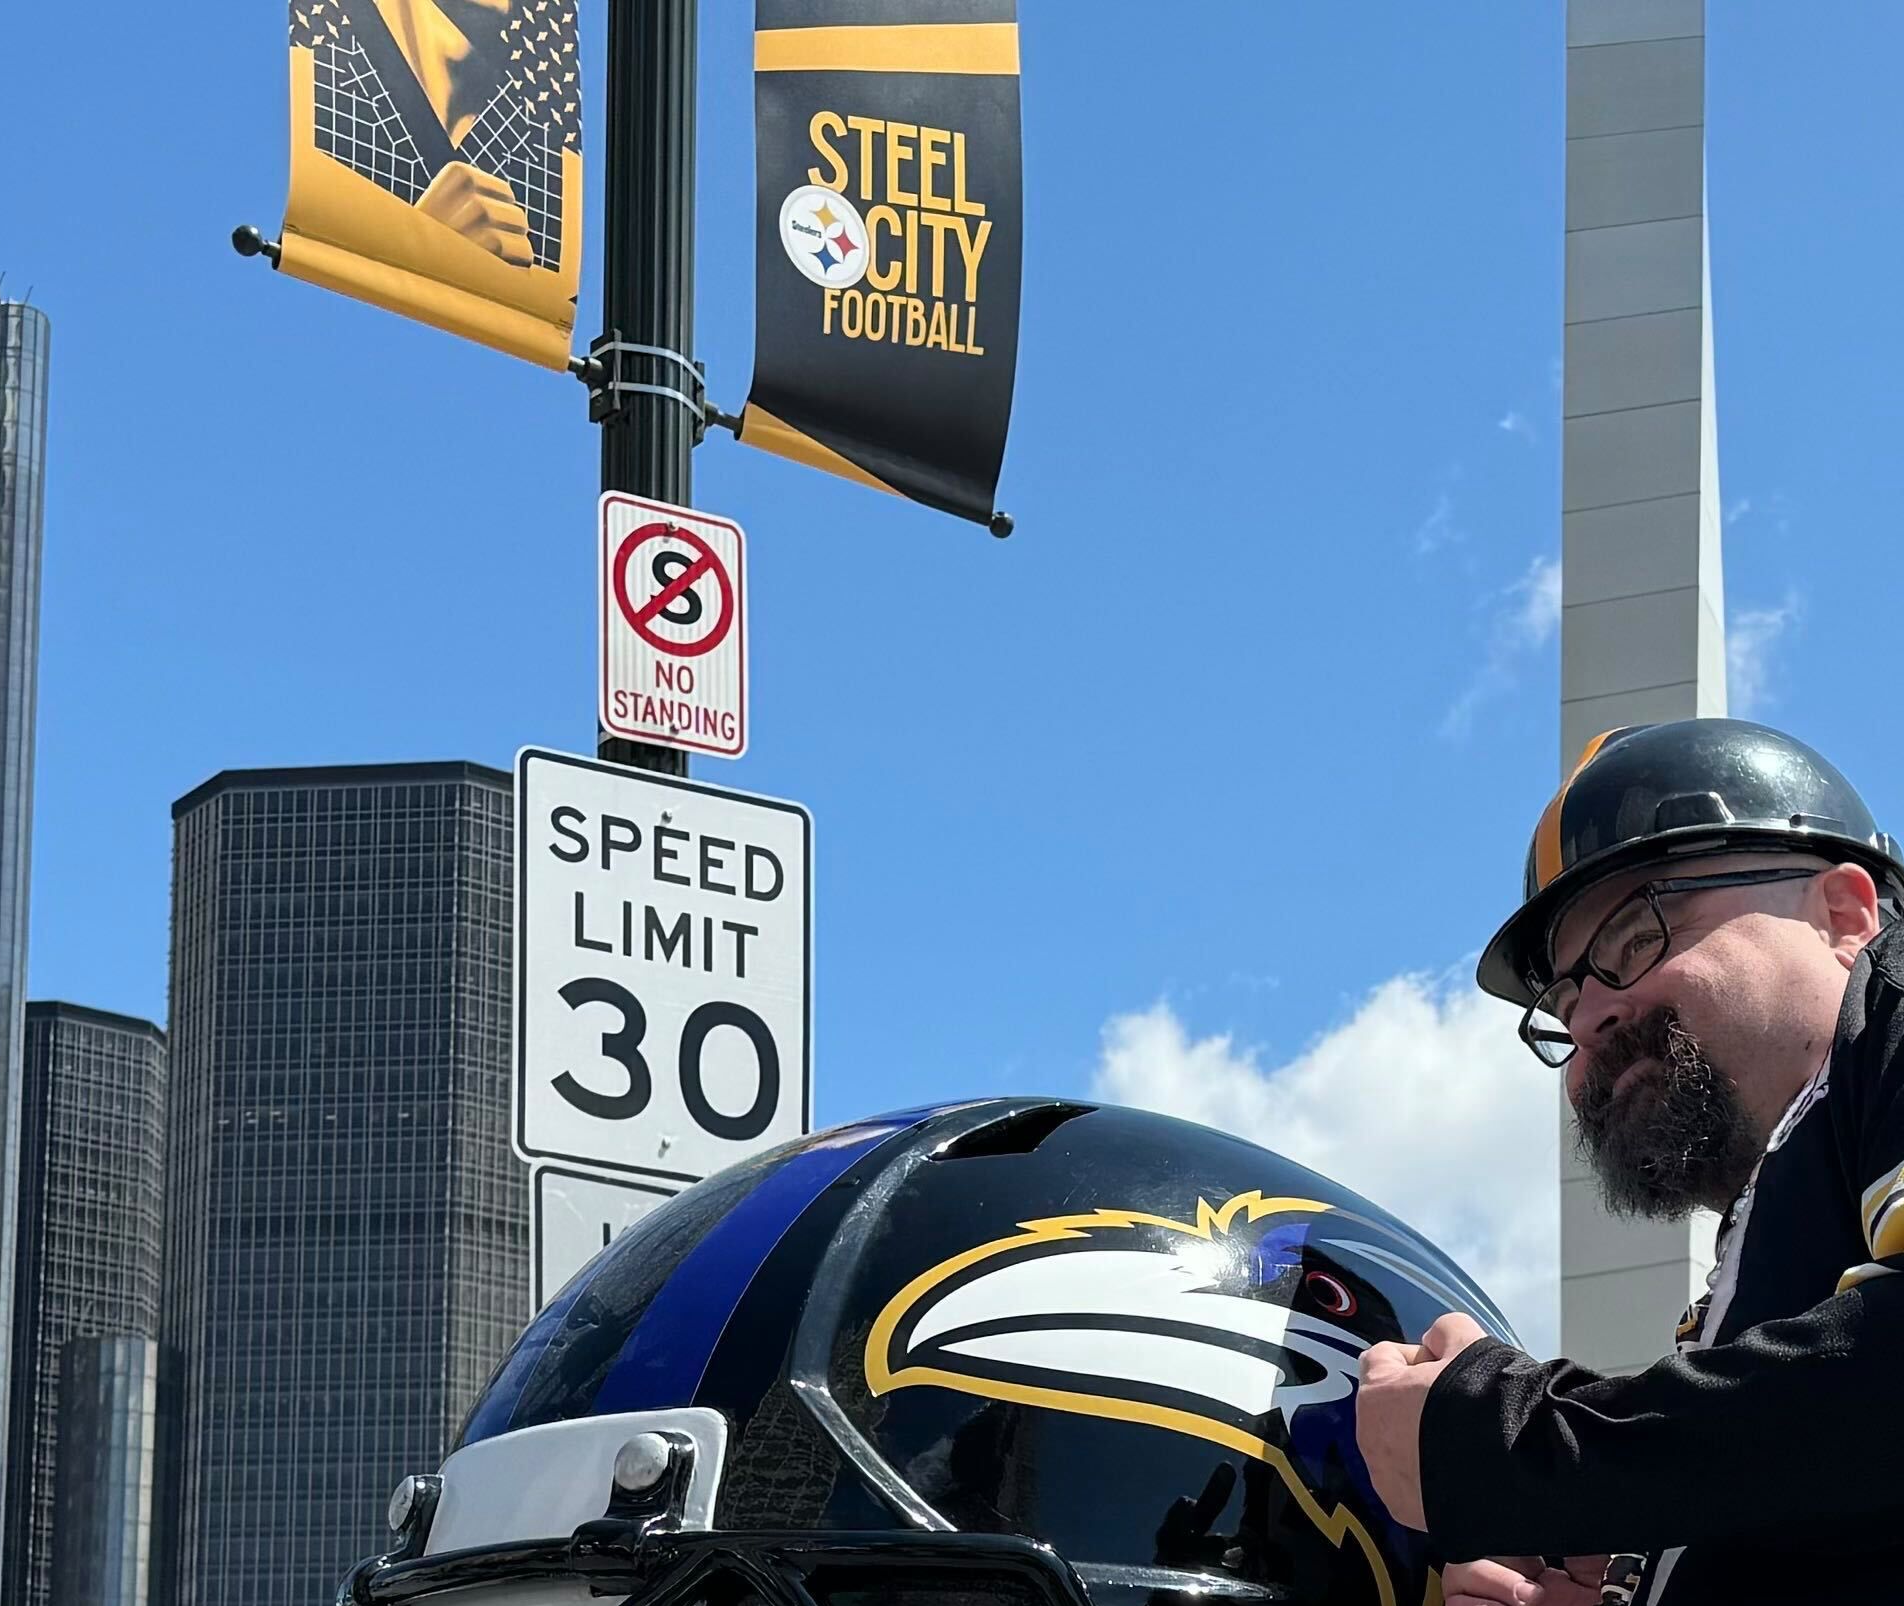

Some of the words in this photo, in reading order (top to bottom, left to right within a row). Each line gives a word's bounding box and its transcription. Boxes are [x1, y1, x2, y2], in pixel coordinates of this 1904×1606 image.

[807, 110, 986, 217] STEEL
[865, 204, 993, 303] CITY
[823, 288, 985, 356] FOOTBALL
[613, 689, 736, 742] STANDING
[655, 660, 695, 695] NO
[548, 805, 785, 902] SPEED
[574, 890, 759, 978] LIMIT
[550, 976, 781, 1142] 30
